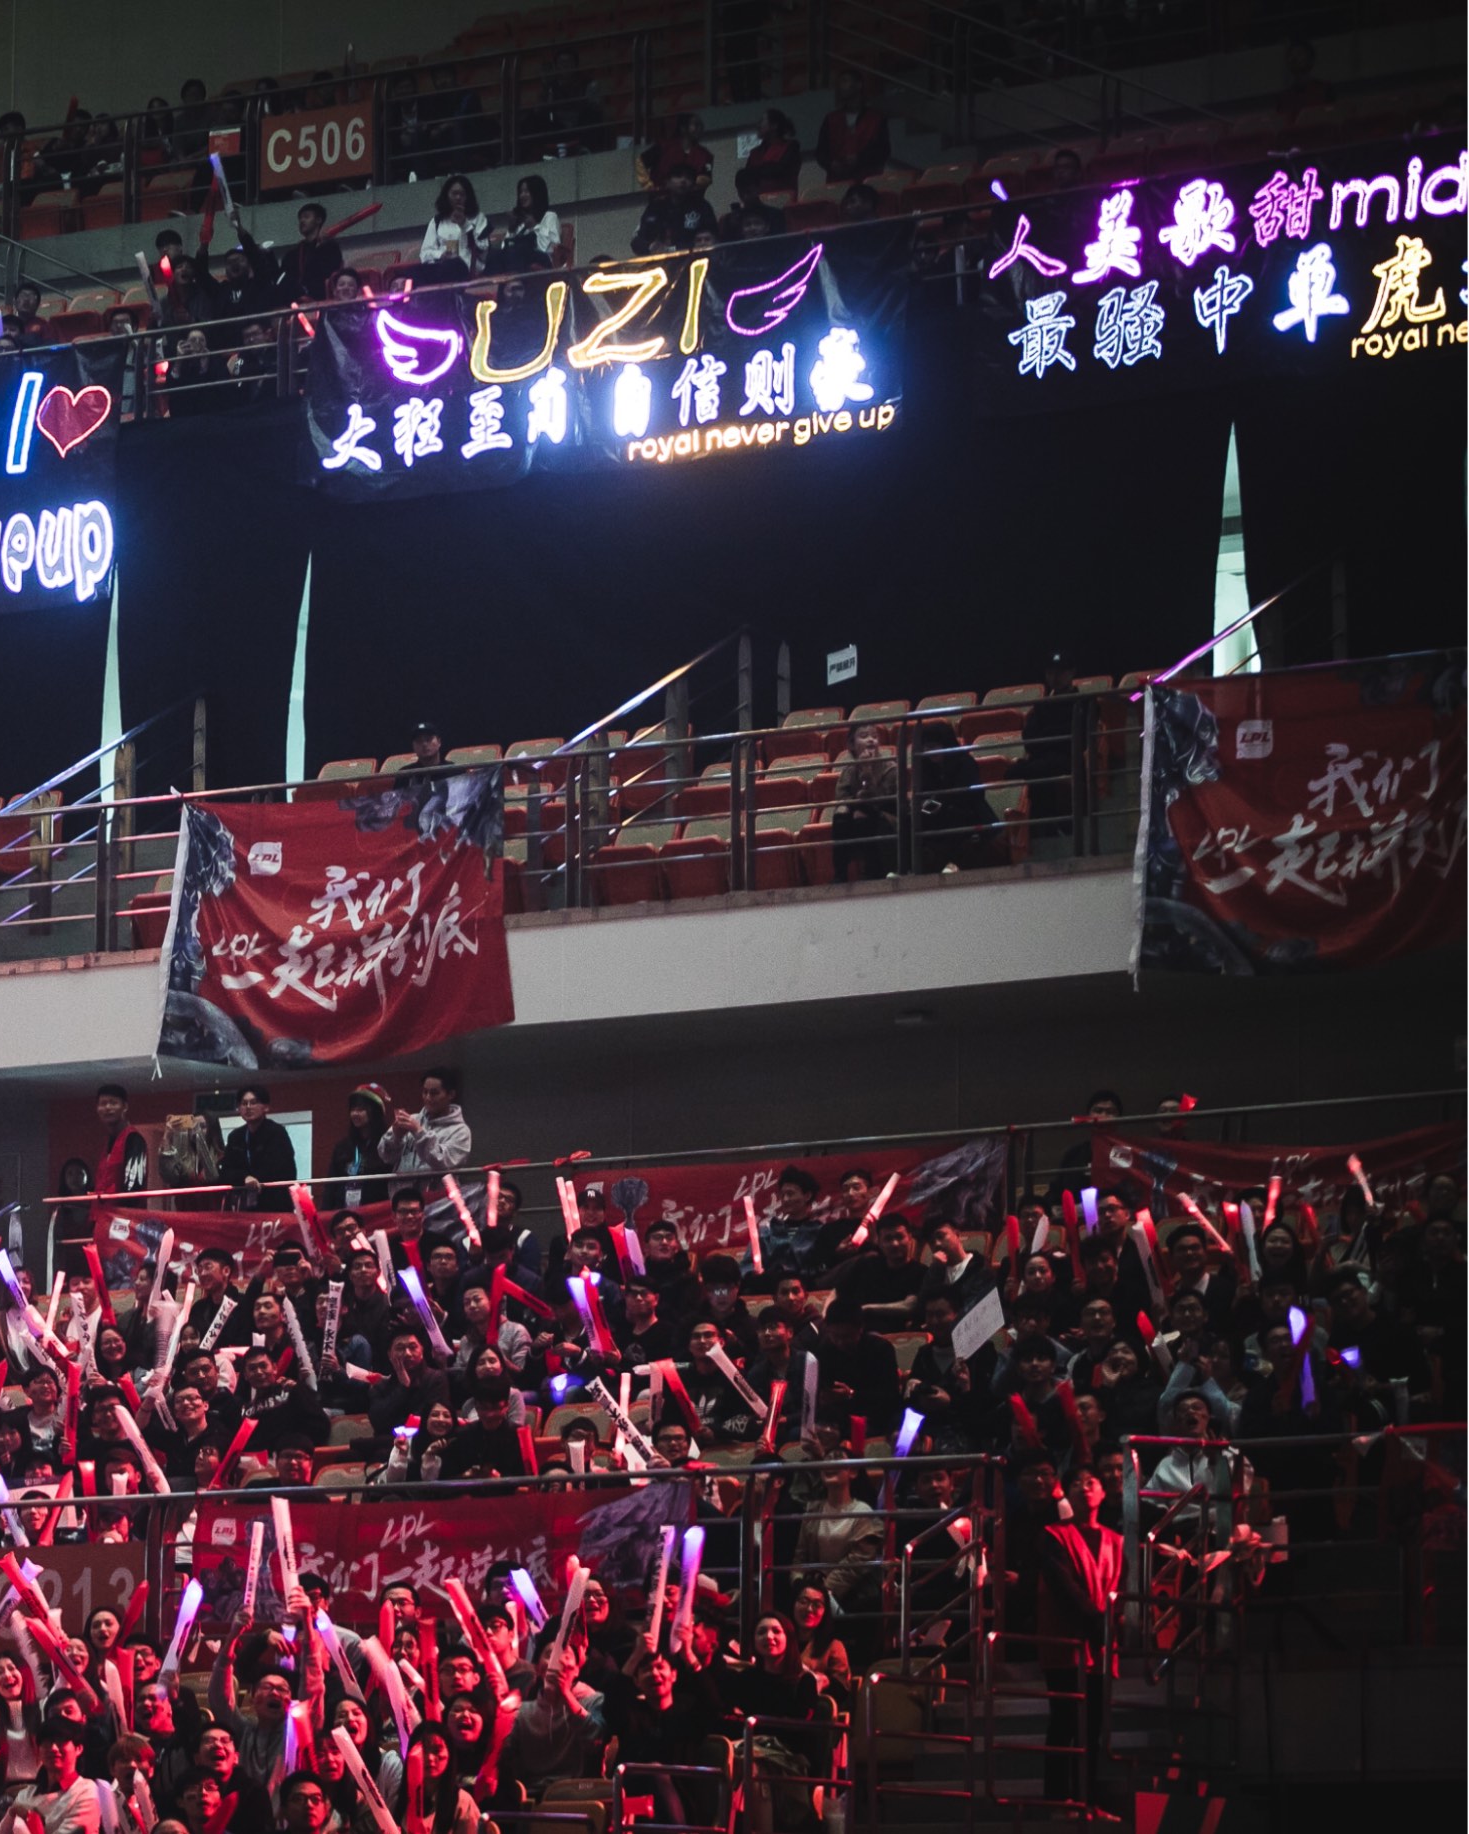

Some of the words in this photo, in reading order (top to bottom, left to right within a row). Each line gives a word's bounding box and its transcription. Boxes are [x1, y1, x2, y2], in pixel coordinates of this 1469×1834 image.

[267, 117, 365, 173] C506
[470, 257, 709, 384] UZI
[1351, 325, 1429, 359] royal
[628, 429, 699, 462] royal
[706, 420, 790, 450] never
[793, 410, 853, 445] give
[859, 404, 895, 431] up
[1307, 743, 1440, 817] 我们
[307, 861, 425, 931] 我们
[380, 1510, 436, 1553] LPL
